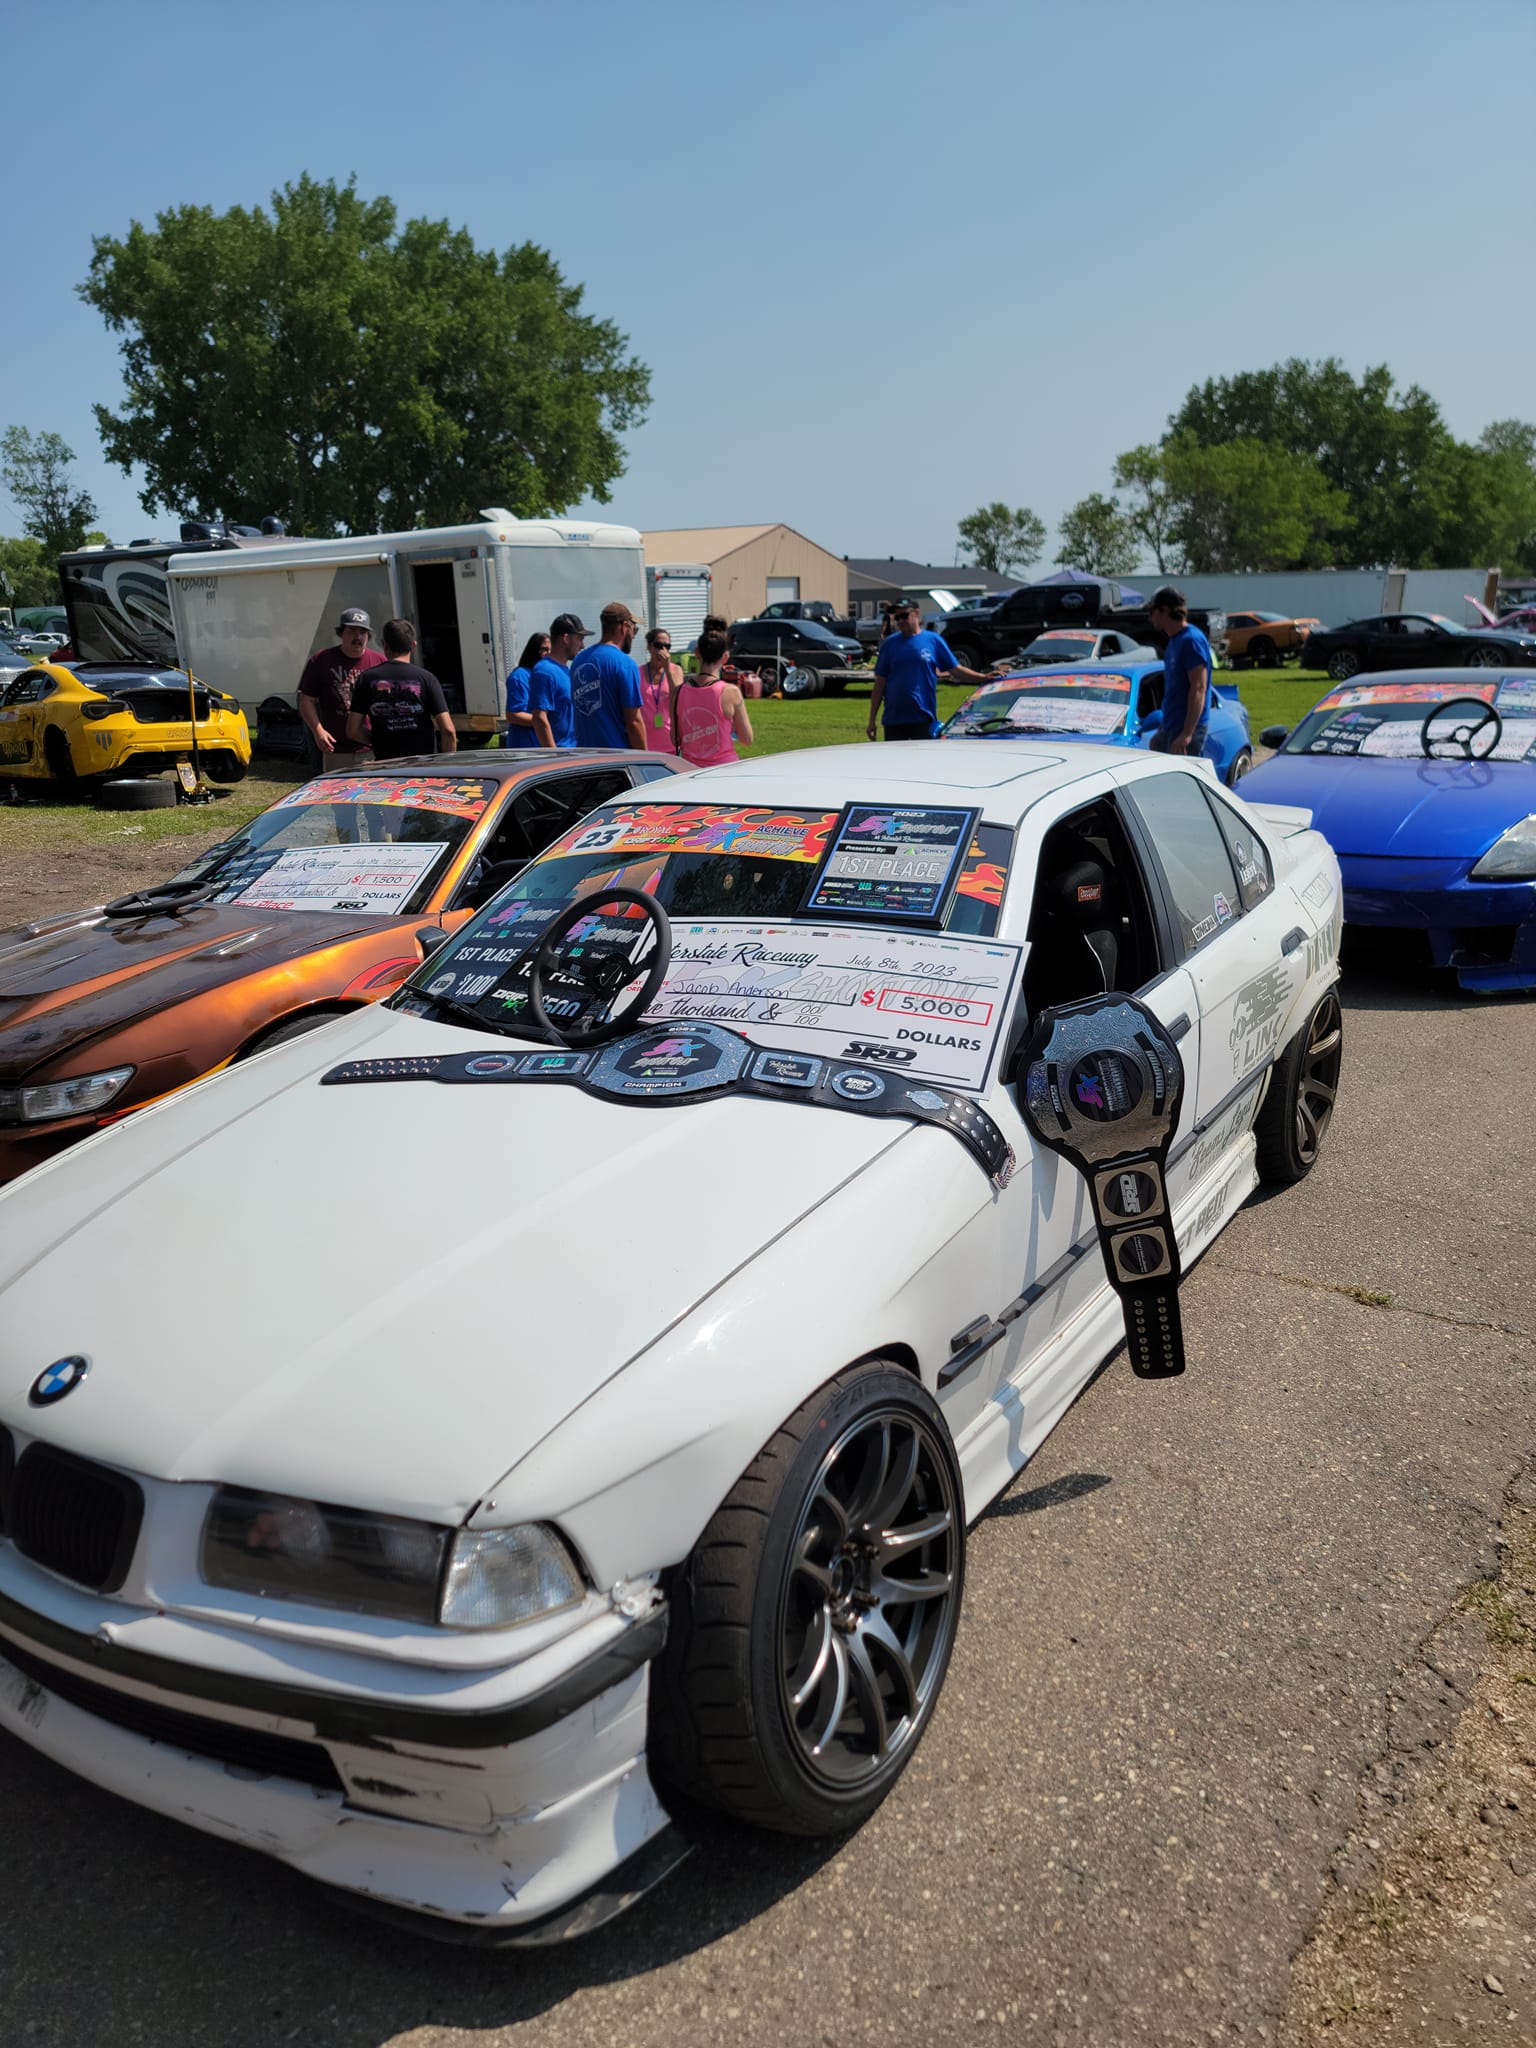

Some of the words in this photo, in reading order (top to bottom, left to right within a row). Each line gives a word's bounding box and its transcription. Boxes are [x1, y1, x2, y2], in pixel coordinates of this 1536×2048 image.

[574, 829, 622, 850] 23
[640, 826, 672, 834] ROYAL
[755, 826, 810, 836] ACHIEVE
[839, 855, 874, 874] 1ST
[877, 859, 940, 879] PLACE
[352, 875, 361, 884] $
[454, 946, 482, 961] 1ST
[477, 948, 522, 962] PLACE
[670, 942, 728, 962] terstate
[731, 942, 819, 968] Raceway
[846, 954, 873, 969] July
[910, 962, 957, 977] 2023
[491, 989, 529, 1003] DRIF
[673, 980, 720, 995] Jacob
[728, 980, 789, 999] Anderson
[670, 999, 756, 1020] thousand
[759, 1002, 783, 1022] &
[860, 988, 876, 1007] $
[901, 996, 970, 1019] 5,000
[896, 1028, 982, 1051] DOLLARS
[840, 1040, 918, 1067] SRD
[1119, 1173, 1141, 1214] SRD
